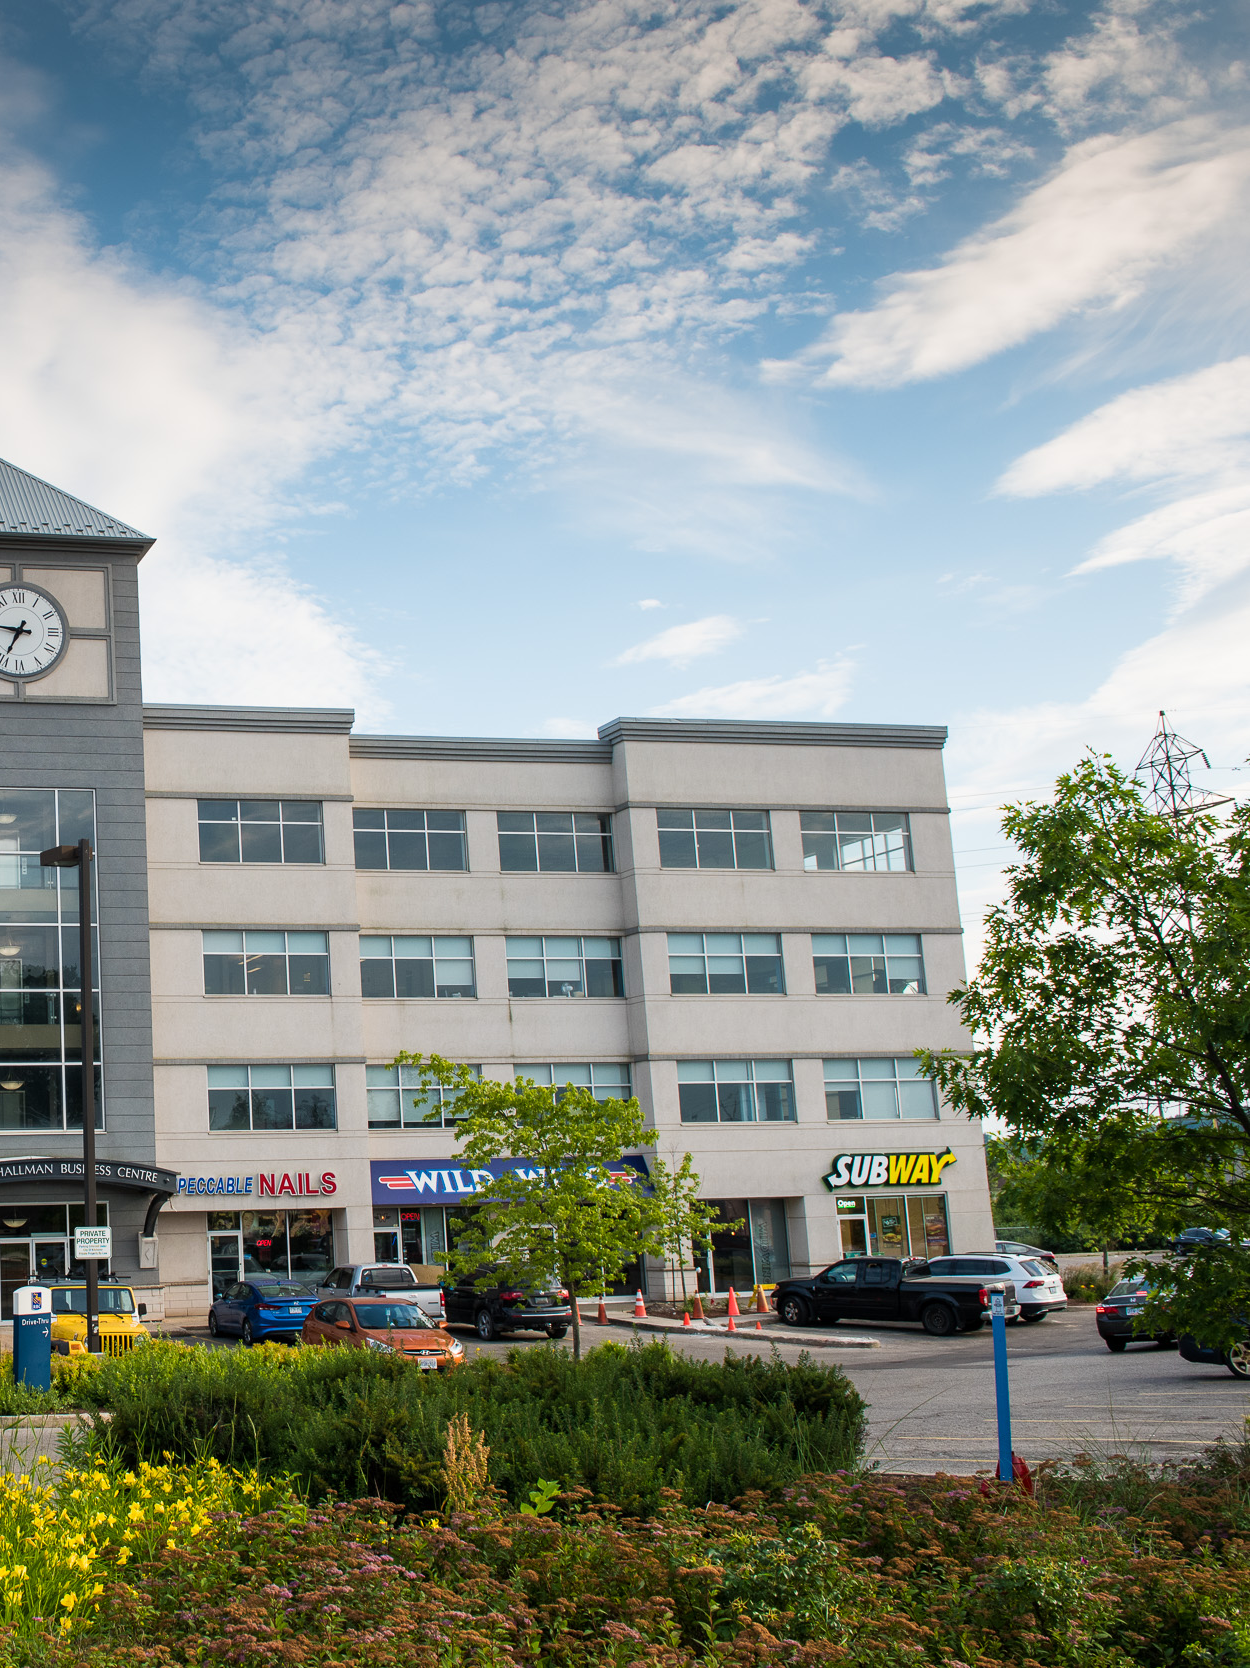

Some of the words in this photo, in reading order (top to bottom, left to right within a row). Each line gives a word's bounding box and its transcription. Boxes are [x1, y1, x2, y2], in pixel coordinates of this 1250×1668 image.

[12, 592, 25, 603] XII
[32, 598, 39, 608] I
[42, 610, 54, 620] II
[47, 627, 59, 637] III
[60, 1163, 112, 1177] BUSIESS
[116, 1166, 159, 1183] CENTRE
[827, 1151, 958, 1188] SUBWAY
[176, 1176, 254, 1195] PECCABLE
[259, 1172, 338, 1196] NAILS
[404, 1169, 495, 1194] WILD
[837, 1199, 856, 1208] Open
[400, 1212, 421, 1221] OPEN
[256, 1239, 272, 1247] OPEN
